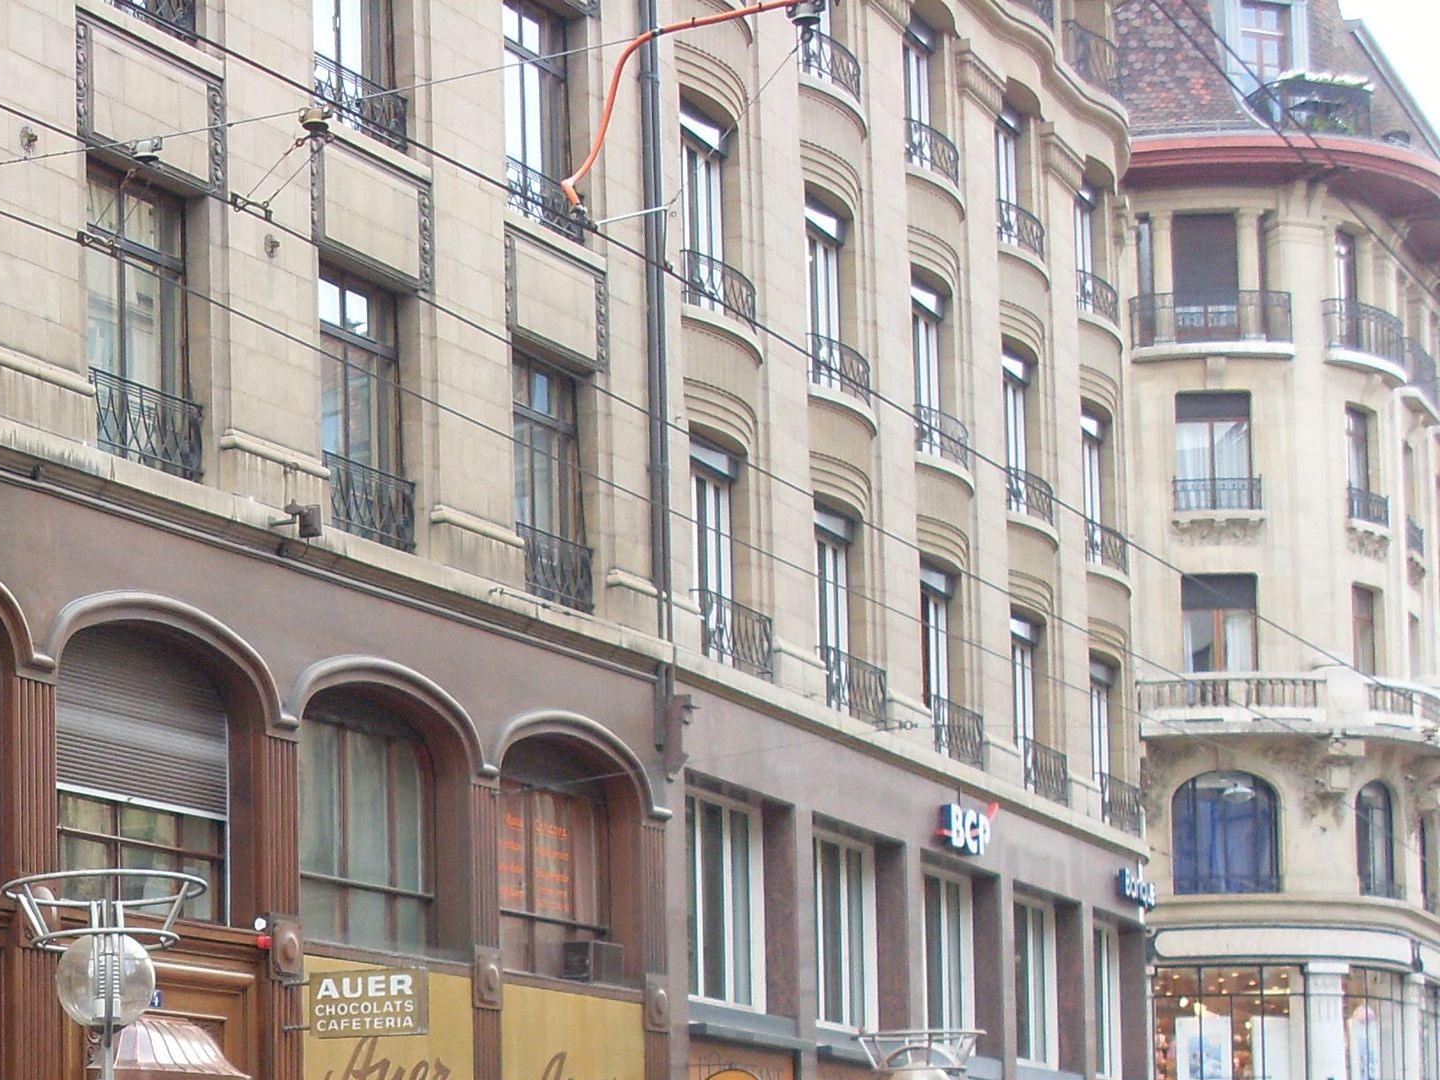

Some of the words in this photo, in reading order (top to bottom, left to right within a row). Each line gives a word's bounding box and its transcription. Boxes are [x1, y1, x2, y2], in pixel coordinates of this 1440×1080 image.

[948, 802, 991, 855] BCP
[316, 974, 413, 1000] AUER
[315, 1000, 414, 1017] CHOCOLATS
[316, 1016, 413, 1032] CAFETERIA
